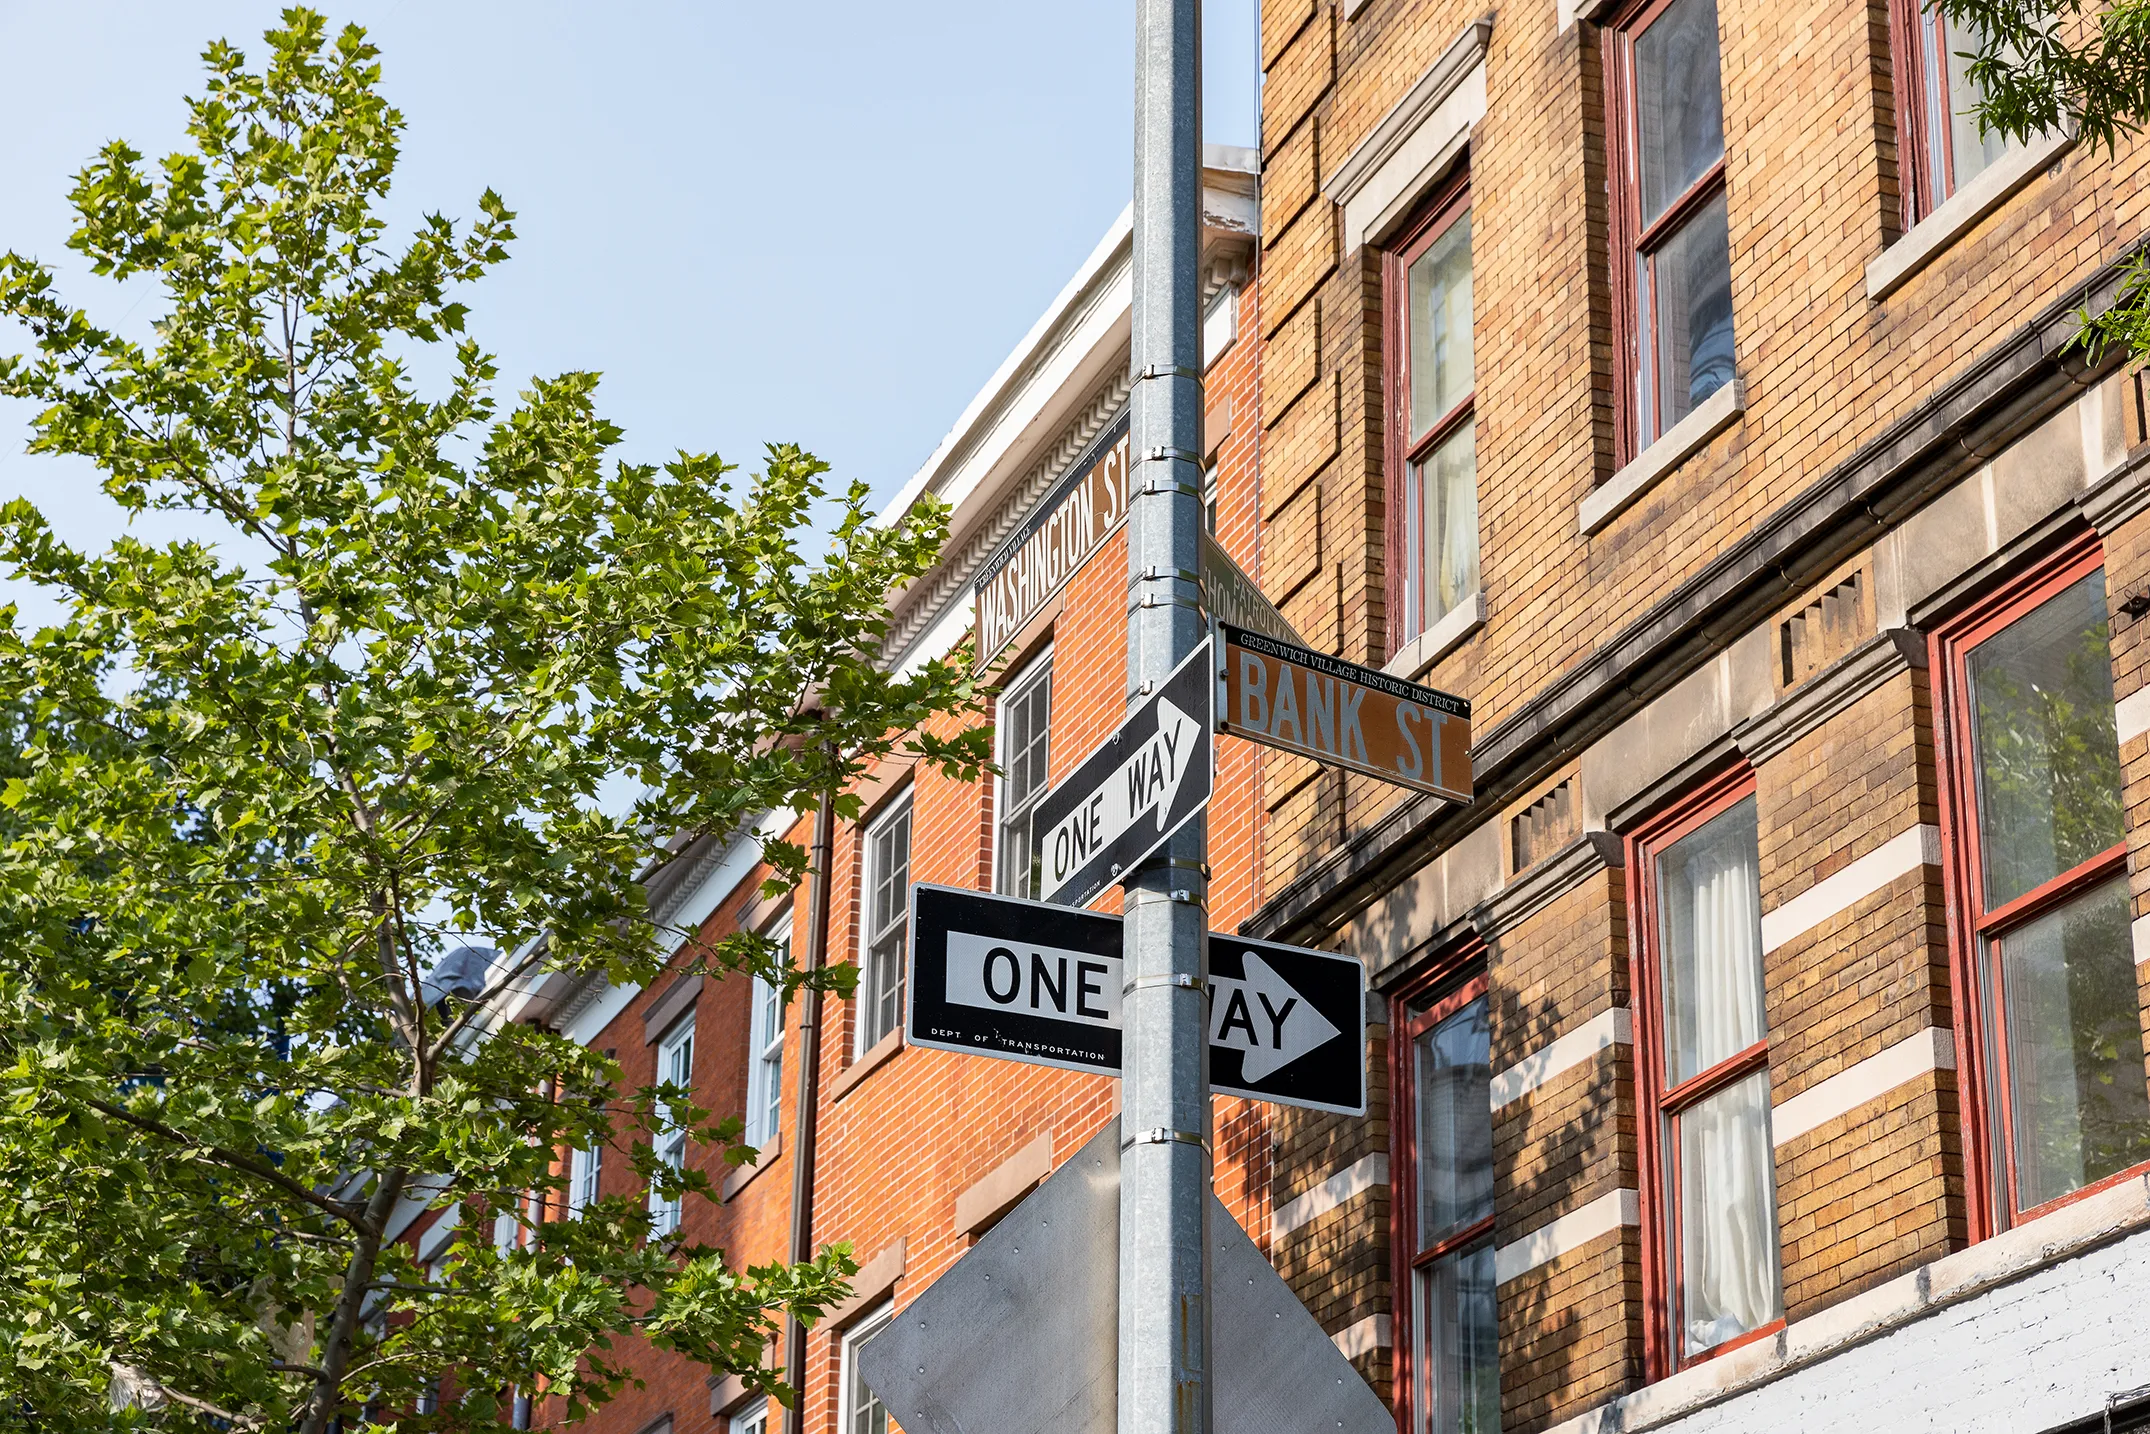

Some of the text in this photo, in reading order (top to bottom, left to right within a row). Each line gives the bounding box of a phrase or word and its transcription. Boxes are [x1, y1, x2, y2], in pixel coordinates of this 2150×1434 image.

[980, 433, 1129, 659] WASHINGTON ST
[1205, 566, 1255, 630] HOMA
[1240, 633, 1460, 713] GREENWICH VILLAGE HISTORIC DISTRICT
[1240, 651, 1448, 788] BANK ST
[1054, 718, 1183, 882] ONE WAY
[1070, 880, 1101, 908] SPORTATION
[982, 948, 1299, 1050] ONE AY
[974, 1034, 989, 1043] OF
[1001, 1038, 1106, 1061] TRANSPORTATION
